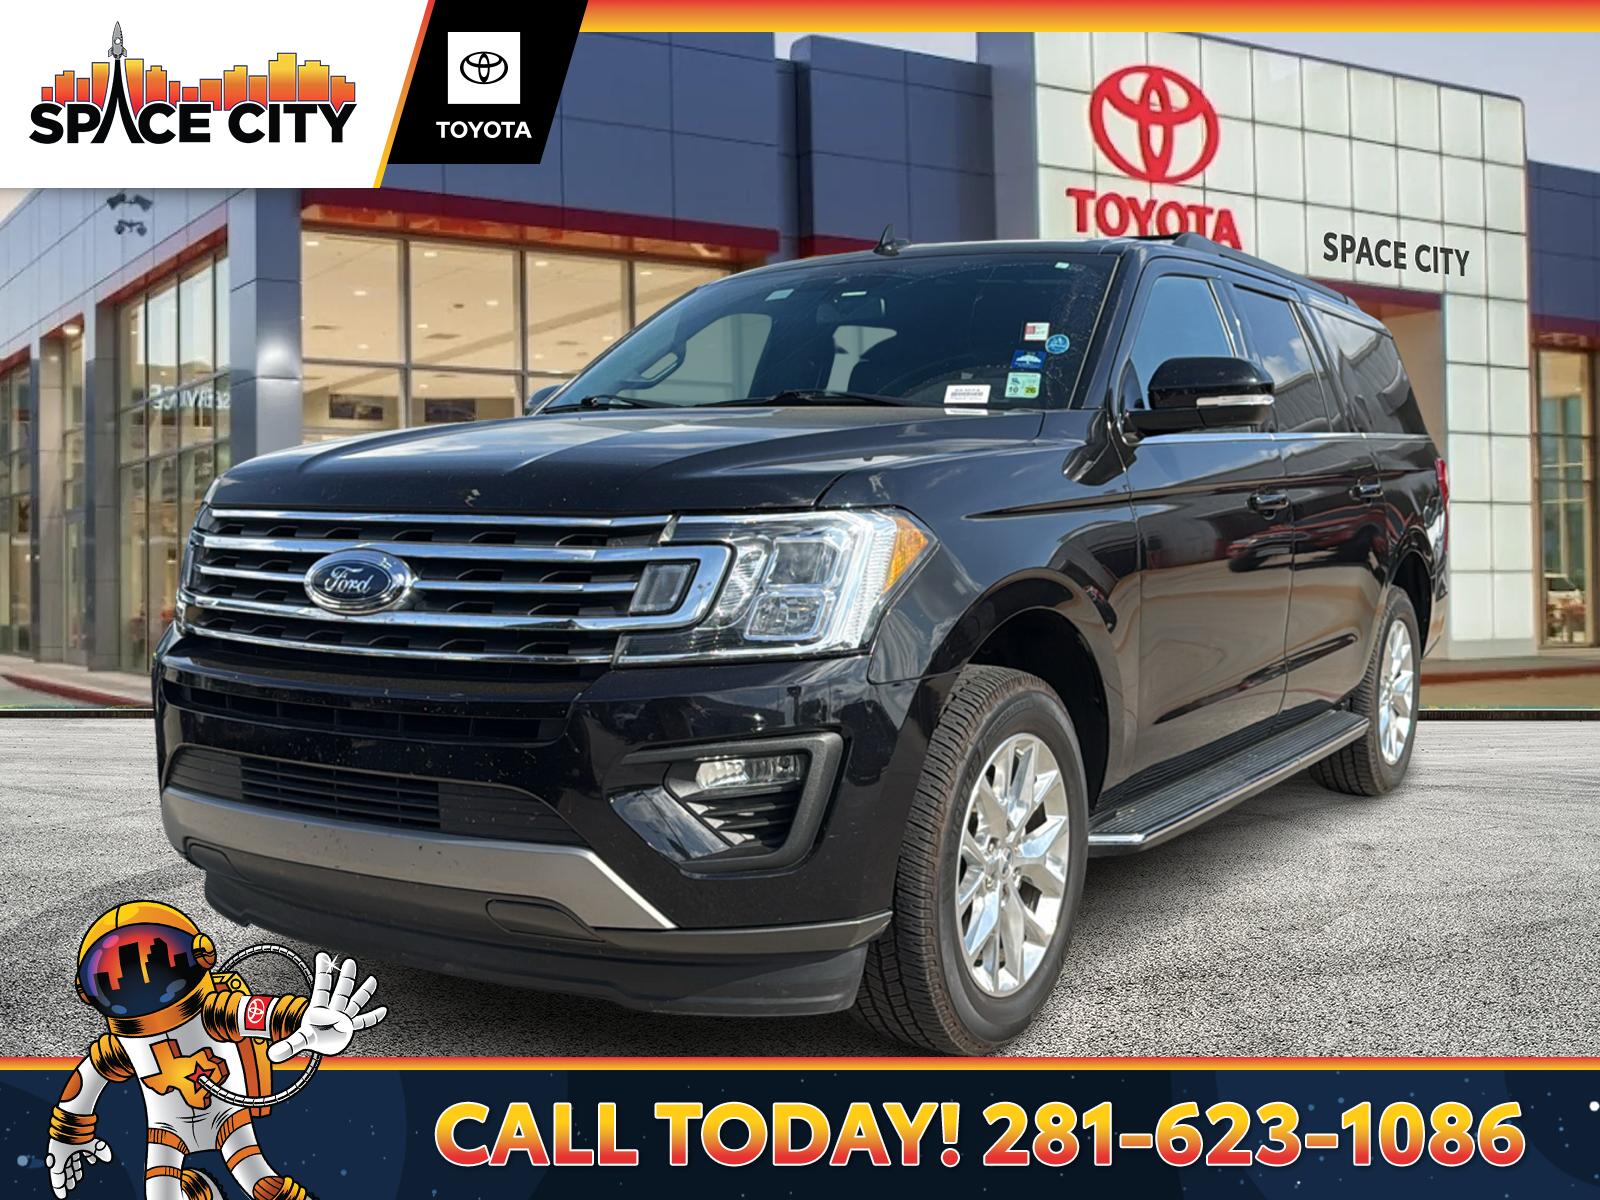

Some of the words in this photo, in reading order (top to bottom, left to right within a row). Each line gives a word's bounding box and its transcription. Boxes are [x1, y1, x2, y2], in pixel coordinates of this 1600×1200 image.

[1066, 187, 1243, 250] TOYOTA
[1322, 231, 1407, 270] SPACE
[1414, 243, 1470, 277] CITY
[324, 565, 374, 595] Ford
